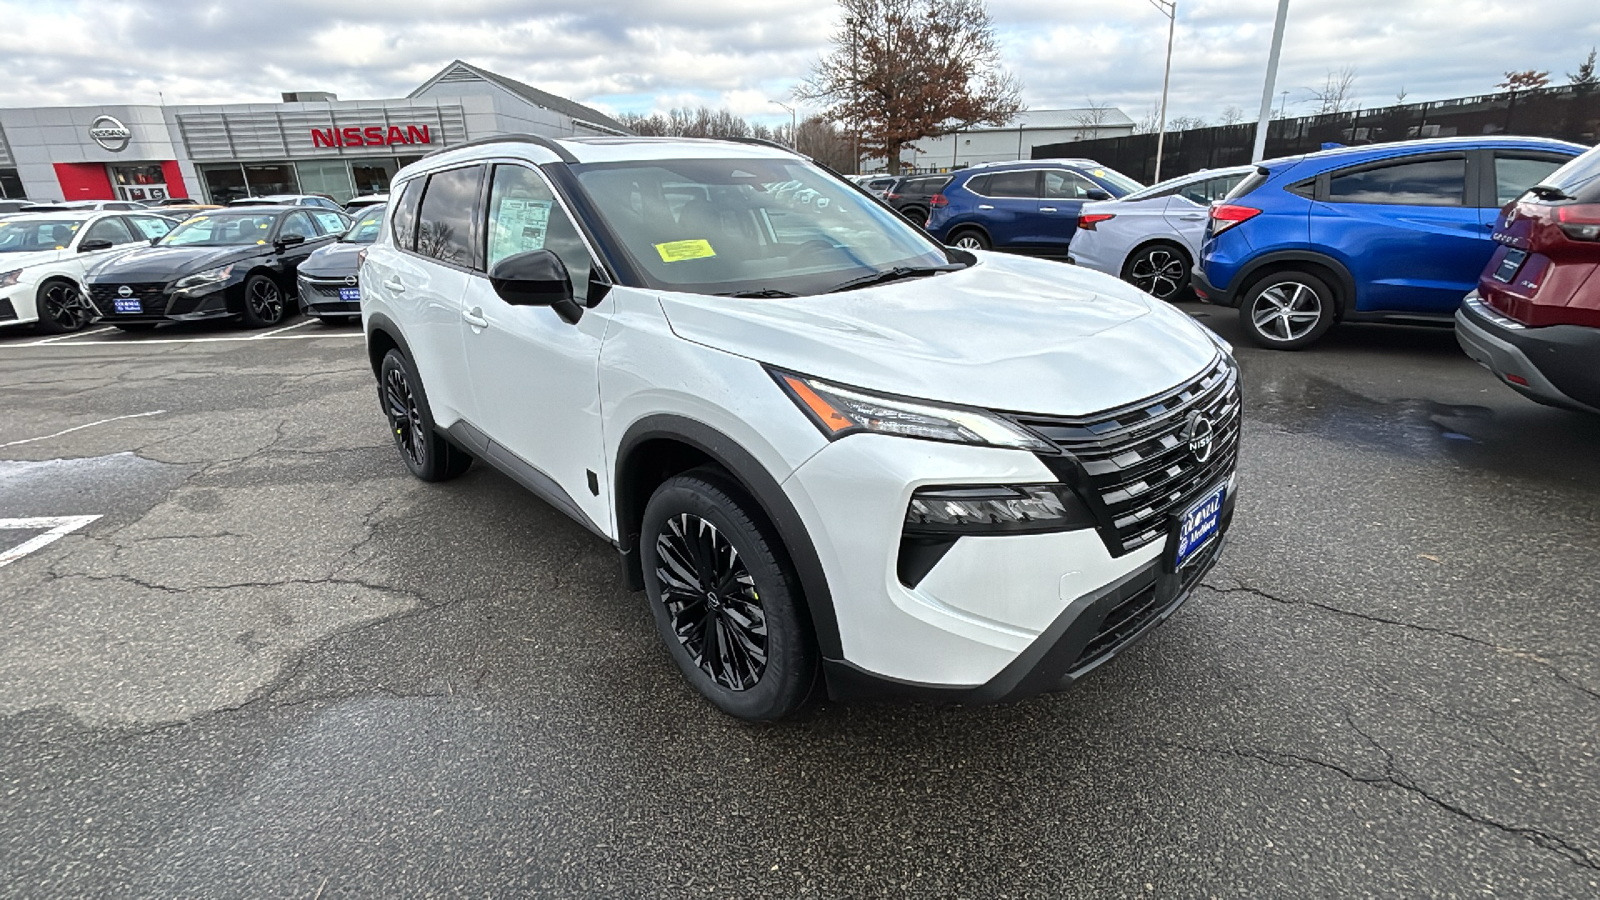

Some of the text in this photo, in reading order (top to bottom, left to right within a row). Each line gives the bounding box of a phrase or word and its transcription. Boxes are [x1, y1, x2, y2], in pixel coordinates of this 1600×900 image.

[91, 129, 126, 137] NISSAN
[310, 125, 431, 148] NISSAN
[1189, 515, 1217, 544] Medford
